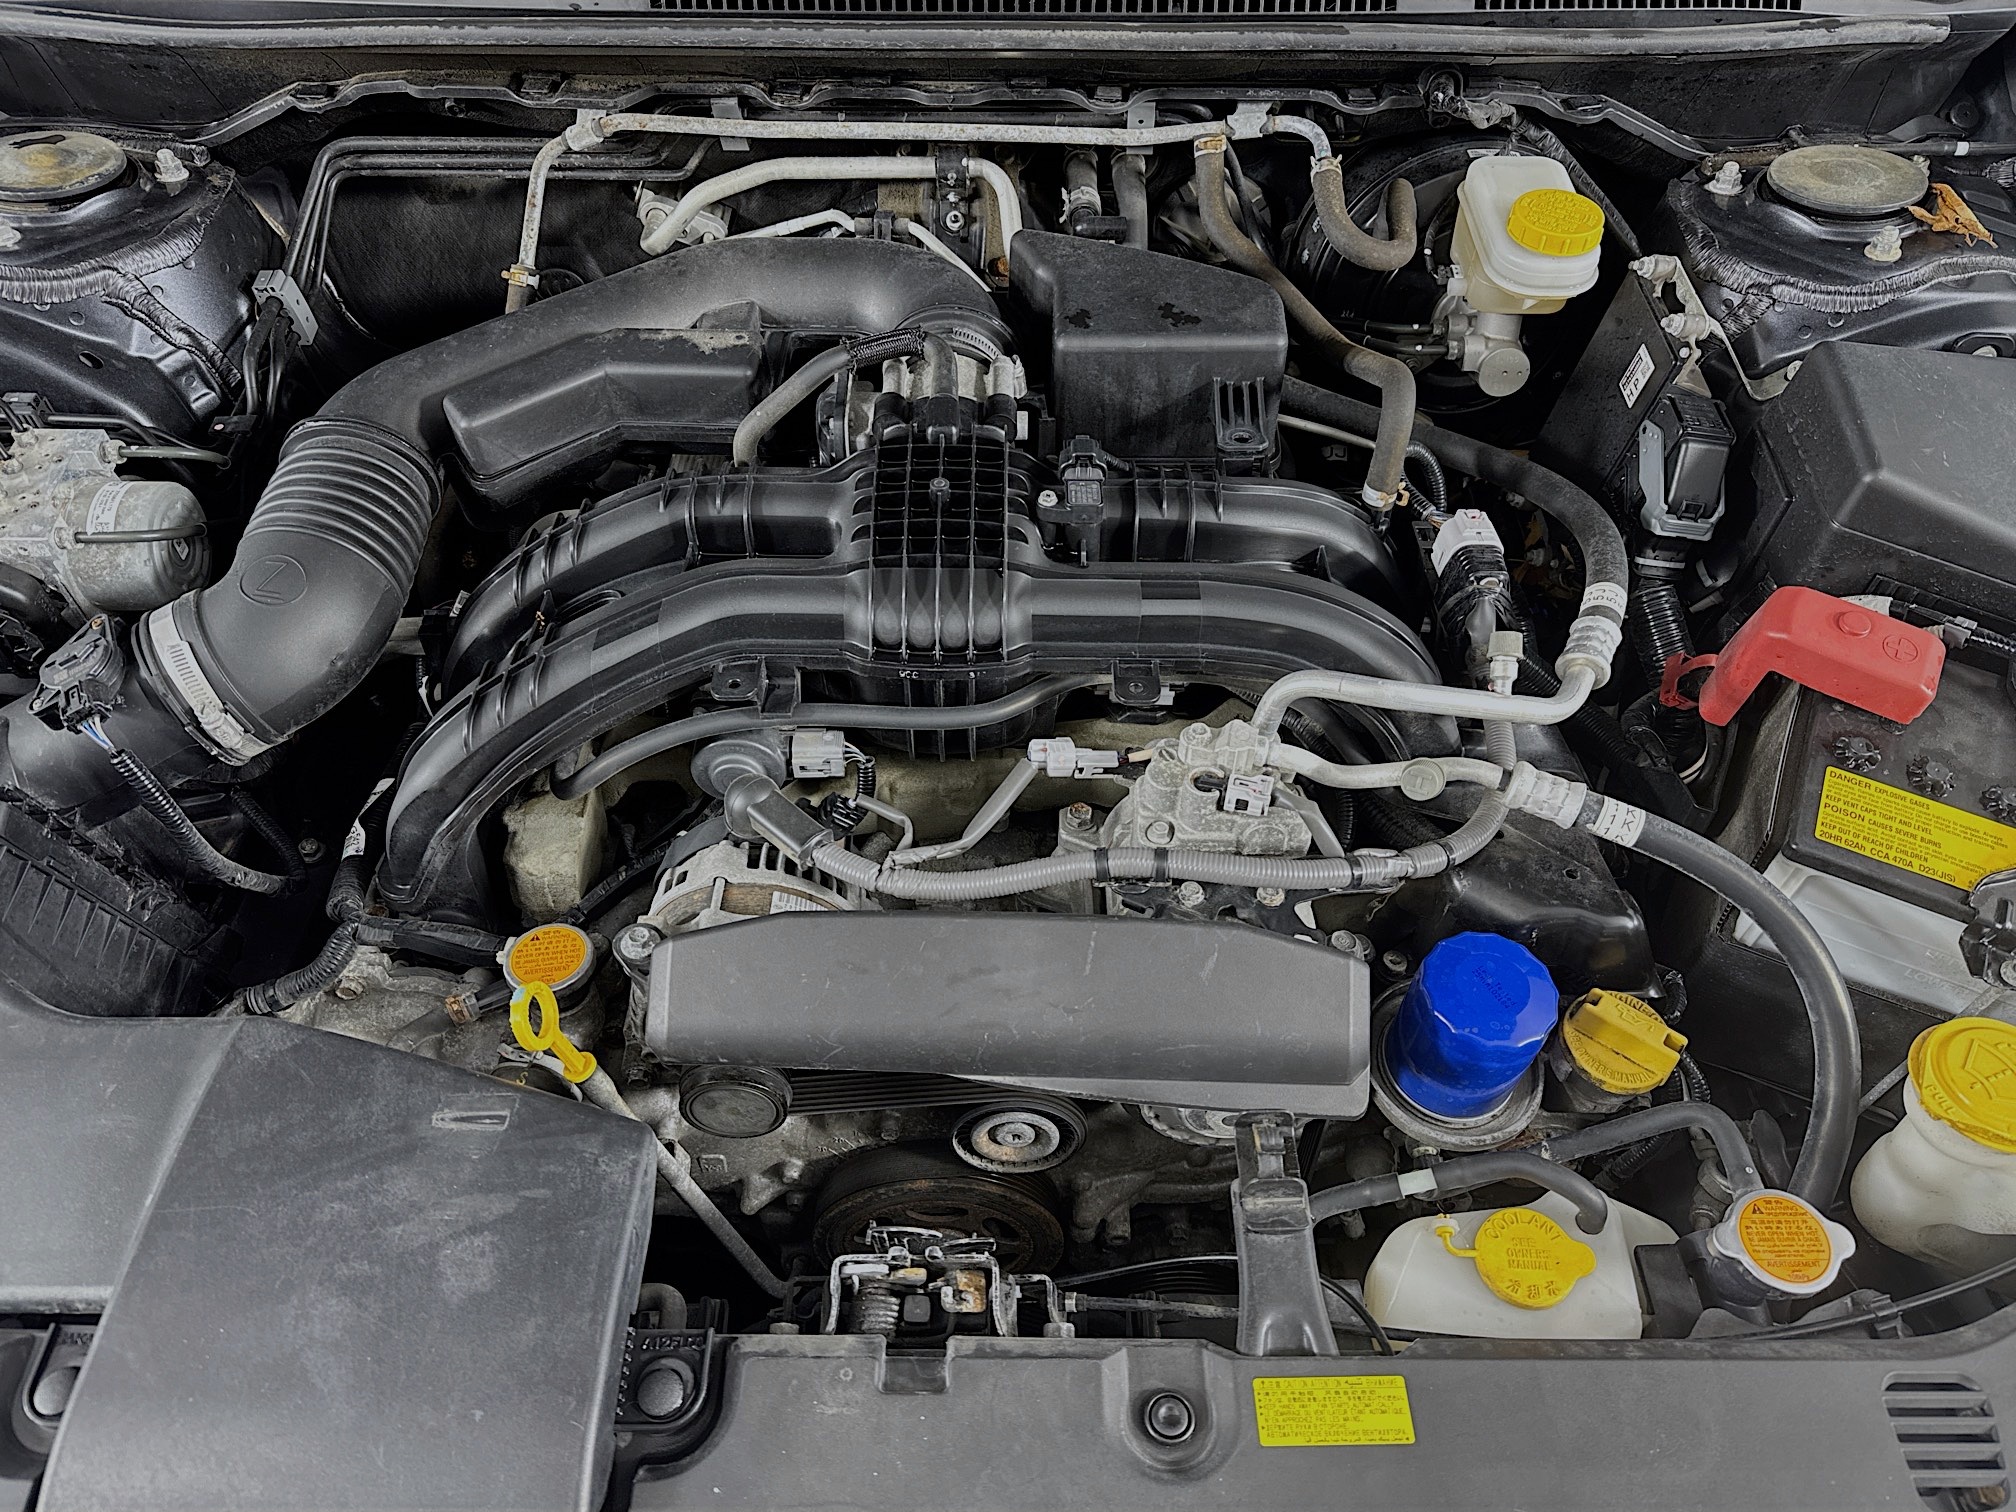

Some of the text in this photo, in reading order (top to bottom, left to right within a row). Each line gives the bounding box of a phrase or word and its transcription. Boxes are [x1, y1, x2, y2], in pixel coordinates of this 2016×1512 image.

[1829, 769, 1930, 810] DANGER EXPLOSIVE GASES
[1823, 802, 1942, 848] POISON CAUSES SEVERE BURNS
[1825, 793, 1933, 835] KEEP VENT CAPS TIGHT AND LEVEL
[1914, 818, 1932, 828] proper
[1933, 824, 1961, 838] instruction
[1931, 813, 1951, 824] battery
[1982, 830, 2003, 841] Always
[1820, 820, 1928, 862] KEEP OUT OF REACH OF CHILDREN
[1923, 815, 1932, 823] not
[1933, 818, 1951, 829] charge
[1958, 827, 1968, 835] use
[1969, 830, 1989, 842] booster
[1819, 829, 1842, 844] 20HR
[1843, 837, 1866, 852] 62Ah
[1869, 846, 1890, 860] CCA
[1892, 853, 1913, 868] 470A
[1918, 862, 1956, 882] D23(JIS)
[1917, 842, 1931, 851] with
[1945, 851, 1957, 860] eyes
[523, 965, 571, 976] AVERTISSEMENT
[1567, 1030, 1652, 1084] SEE OWNER'S MANUAL
[1485, 1211, 1564, 1241] COOLANT
[1511, 1237, 1536, 1247] SEE
[1507, 1258, 1553, 1271] MANUAL
[1767, 1260, 1821, 1268] AVERTISSEMENT
